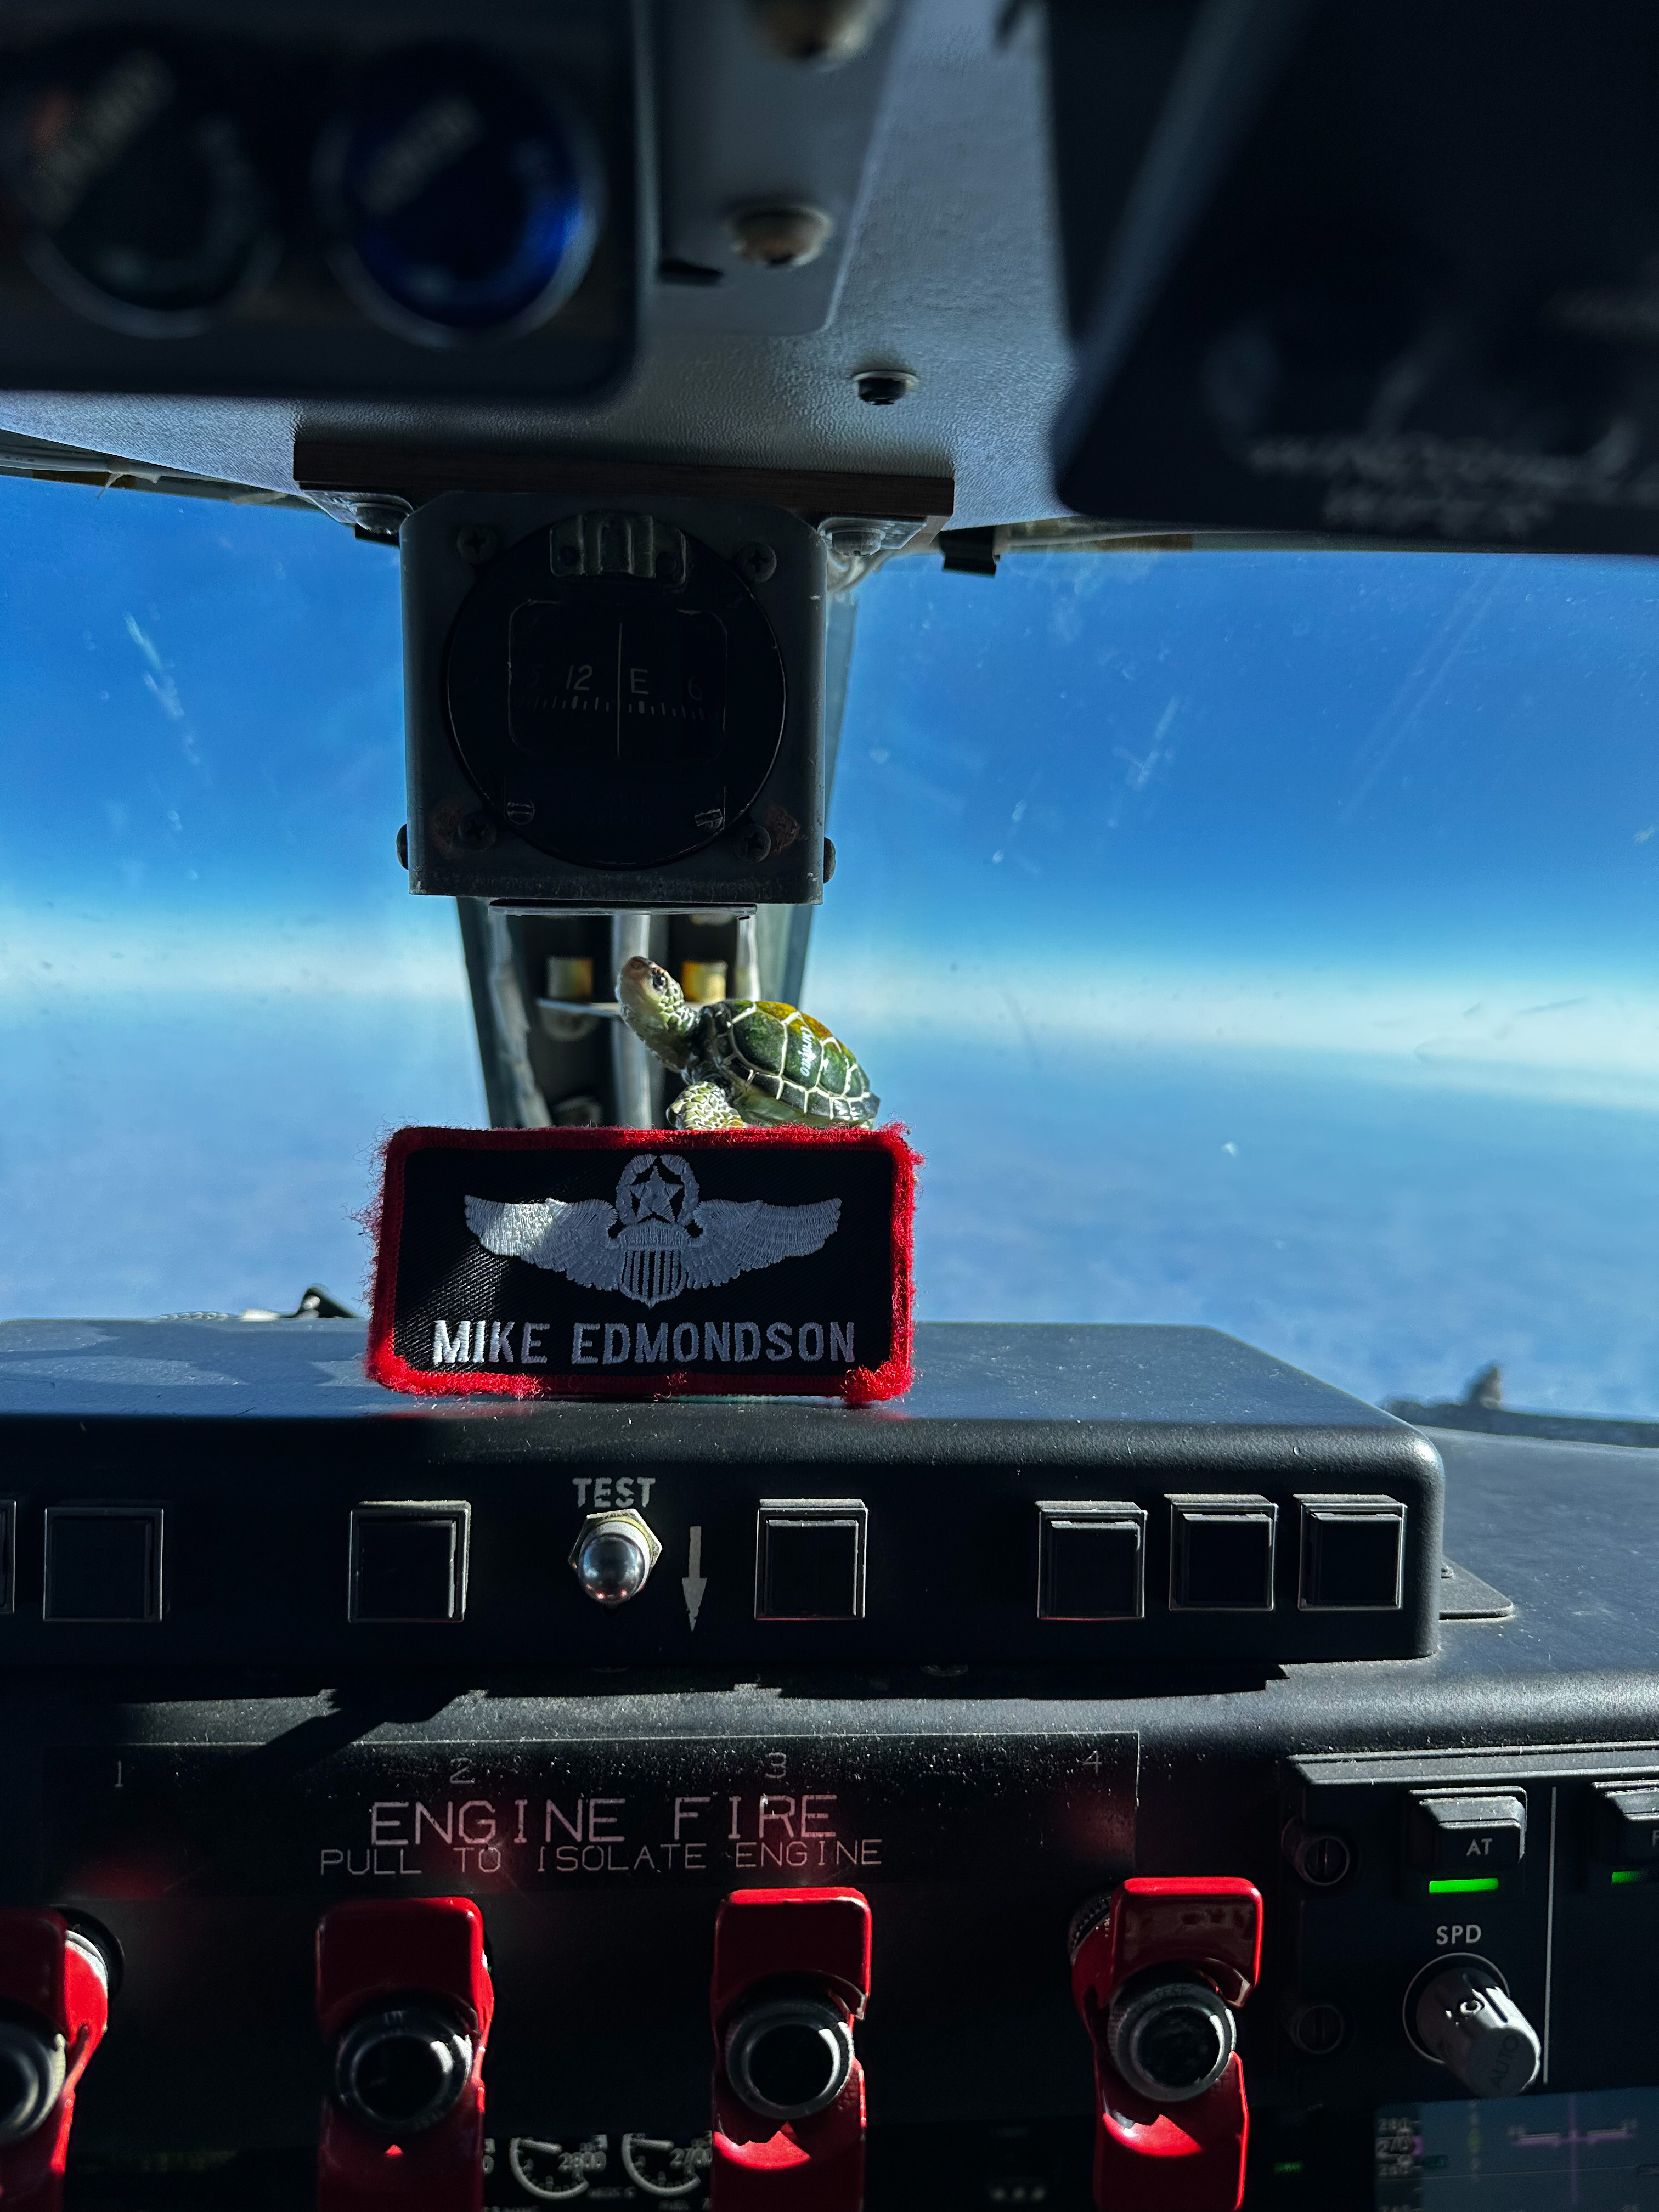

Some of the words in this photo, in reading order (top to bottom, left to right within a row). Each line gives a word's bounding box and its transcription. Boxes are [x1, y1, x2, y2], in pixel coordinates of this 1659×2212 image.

[566, 664, 592, 691] 12
[630, 668, 649, 695] E
[432, 1320, 550, 1364] MIKE
[571, 1321, 855, 1364] EDMONDSON
[572, 1476, 656, 1508] TEST
[449, 1758, 475, 1784] 2
[765, 1752, 787, 1780] 3
[1082, 1749, 1103, 1775] 4
[370, 1795, 626, 1847] ENGINE
[672, 1793, 838, 1841] FIRE
[320, 1848, 422, 1876] PULL
[453, 1846, 501, 1874] TO
[537, 1842, 707, 1873] ISOLATE
[735, 1839, 883, 1868] ENGINE
[1465, 1839, 1493, 1856] AT
[1436, 1925, 1482, 1945] SPD
